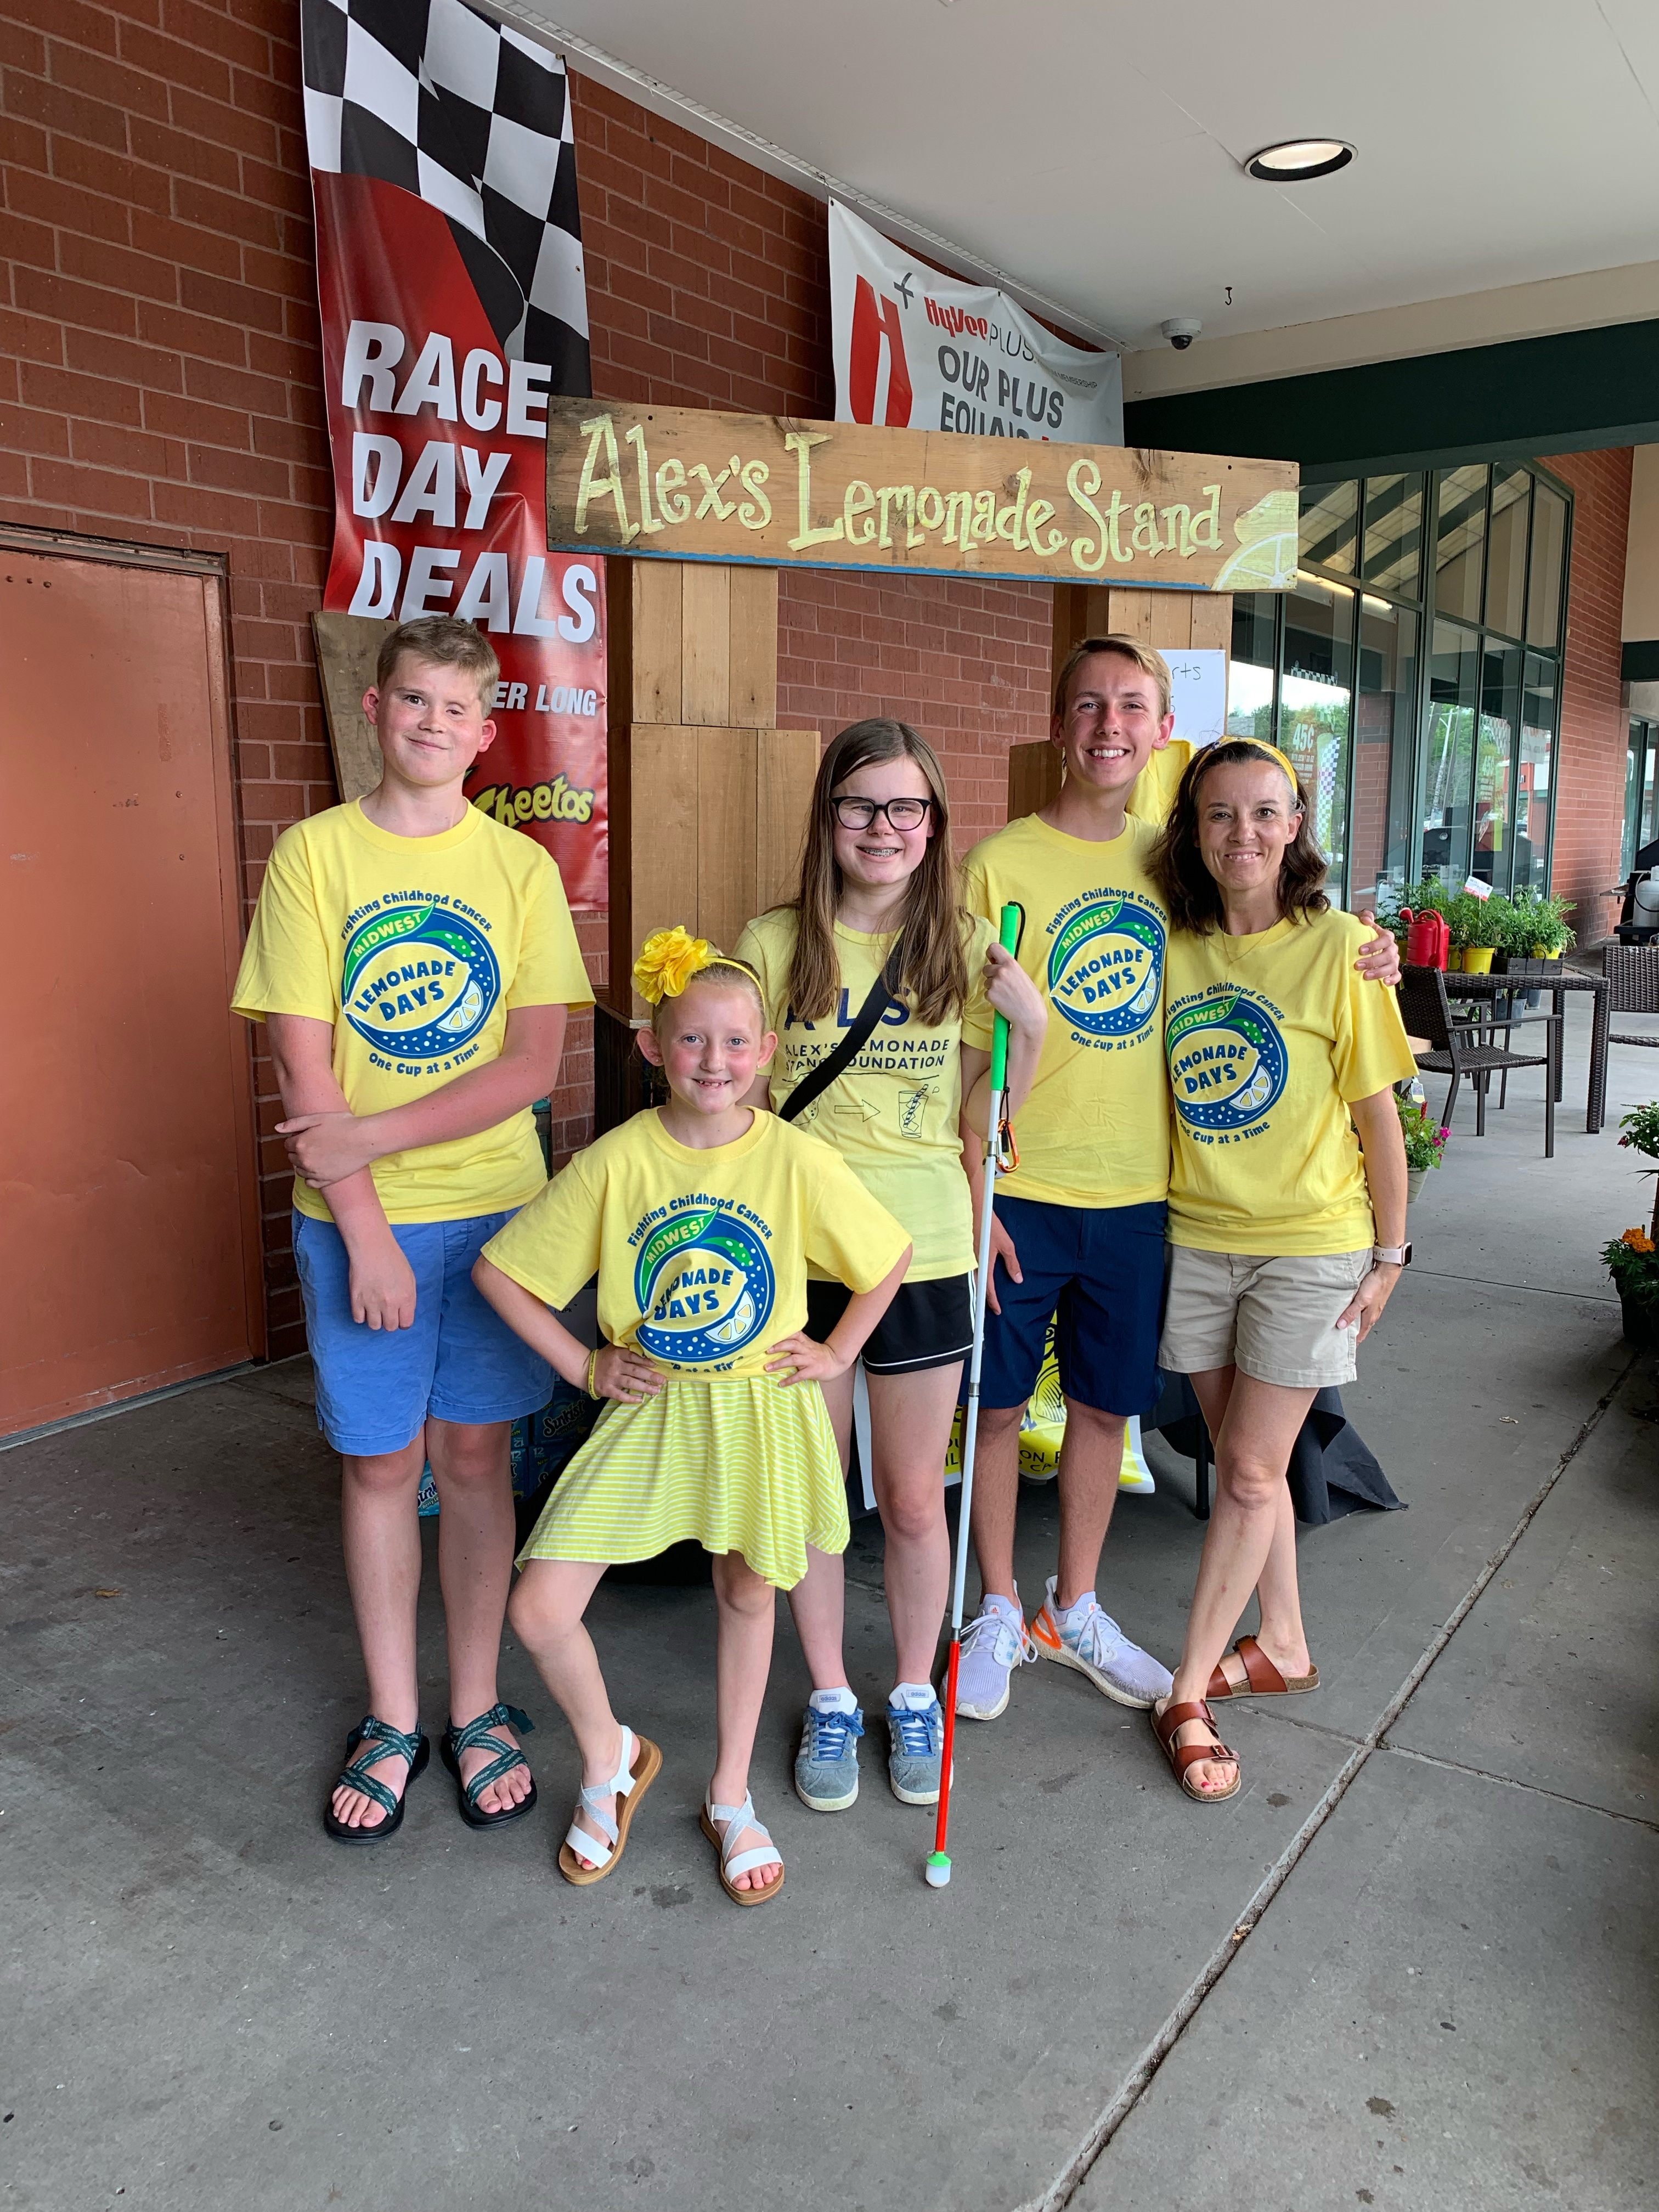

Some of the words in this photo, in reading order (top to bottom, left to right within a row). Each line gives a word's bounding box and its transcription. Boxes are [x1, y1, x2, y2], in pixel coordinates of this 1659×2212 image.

[342, 319, 552, 438] RACE
[938, 346, 989, 402] OUR
[999, 369, 1064, 428] PLUS
[352, 432, 511, 529] DAY
[574, 413, 772, 545] Alex's
[786, 432, 1068, 556] Lemonade
[1066, 459, 1224, 572] Stand
[348, 539, 597, 643] DEALS
[535, 685, 597, 716] LONG
[341, 899, 381, 940] Fighting
[382, 890, 449, 905] Childhood
[453, 898, 493, 933] Cancer
[1046, 898, 1081, 935] Fighting
[1082, 887, 1134, 901] Childhood
[1137, 894, 1167, 923] Cancer
[1062, 907, 1115, 949] MIDWEST
[352, 912, 421, 957] MIDWEST
[354, 960, 456, 1013] LEMONADE
[1059, 949, 1144, 997] LEMONADE
[1082, 967, 1136, 1004] DAYS
[379, 980, 445, 1022] DAYS
[1171, 1002, 1230, 1036] MIDWEST
[1206, 982, 1255, 996] Childhood
[1256, 995, 1285, 1021] Cancer
[1071, 1031, 1092, 1047] One
[1093, 1039, 1113, 1052] Cup
[1116, 1040, 1127, 1050] at
[1137, 1025, 1154, 1043] Time
[369, 1053, 392, 1071] One
[396, 1063, 422, 1077] Cup
[426, 1062, 440, 1074] at
[444, 1062, 452, 1070] a
[453, 1043, 480, 1066] Time
[848, 1055, 945, 1069] OUNDATION
[1184, 1063, 1237, 1094] DAYS
[1193, 1131, 1214, 1145] Cup
[1218, 1132, 1230, 1144] at
[1233, 1134, 1240, 1142] a
[1243, 1121, 1271, 1139] Time
[627, 1206, 667, 1247] Fighting
[669, 1193, 735, 1210] Childhood
[736, 1204, 773, 1240] Cancer
[646, 1217, 705, 1264] MIDWEST
[543, 1399, 585, 1438] Sunkist
[533, 1447, 544, 1455] 12
